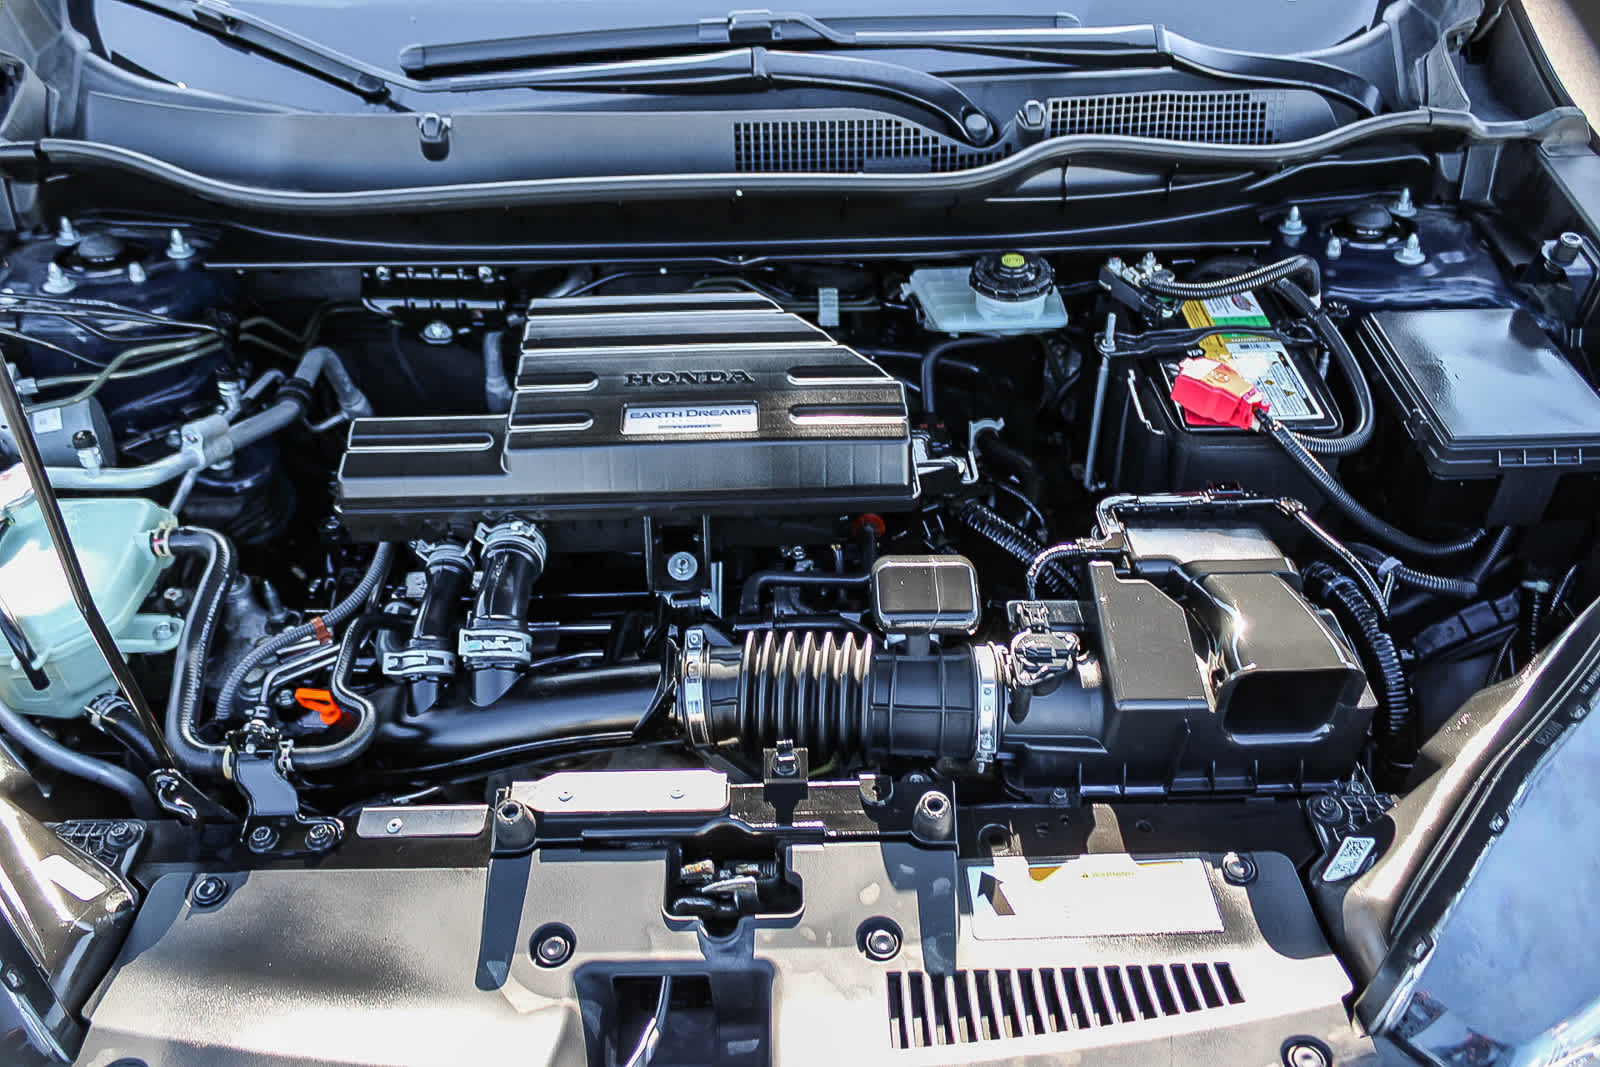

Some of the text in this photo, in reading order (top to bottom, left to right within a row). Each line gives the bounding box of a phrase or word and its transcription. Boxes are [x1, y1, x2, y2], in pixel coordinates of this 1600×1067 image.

[624, 369, 755, 387] HONDA
[630, 409, 751, 419] EARTH DREAMS
